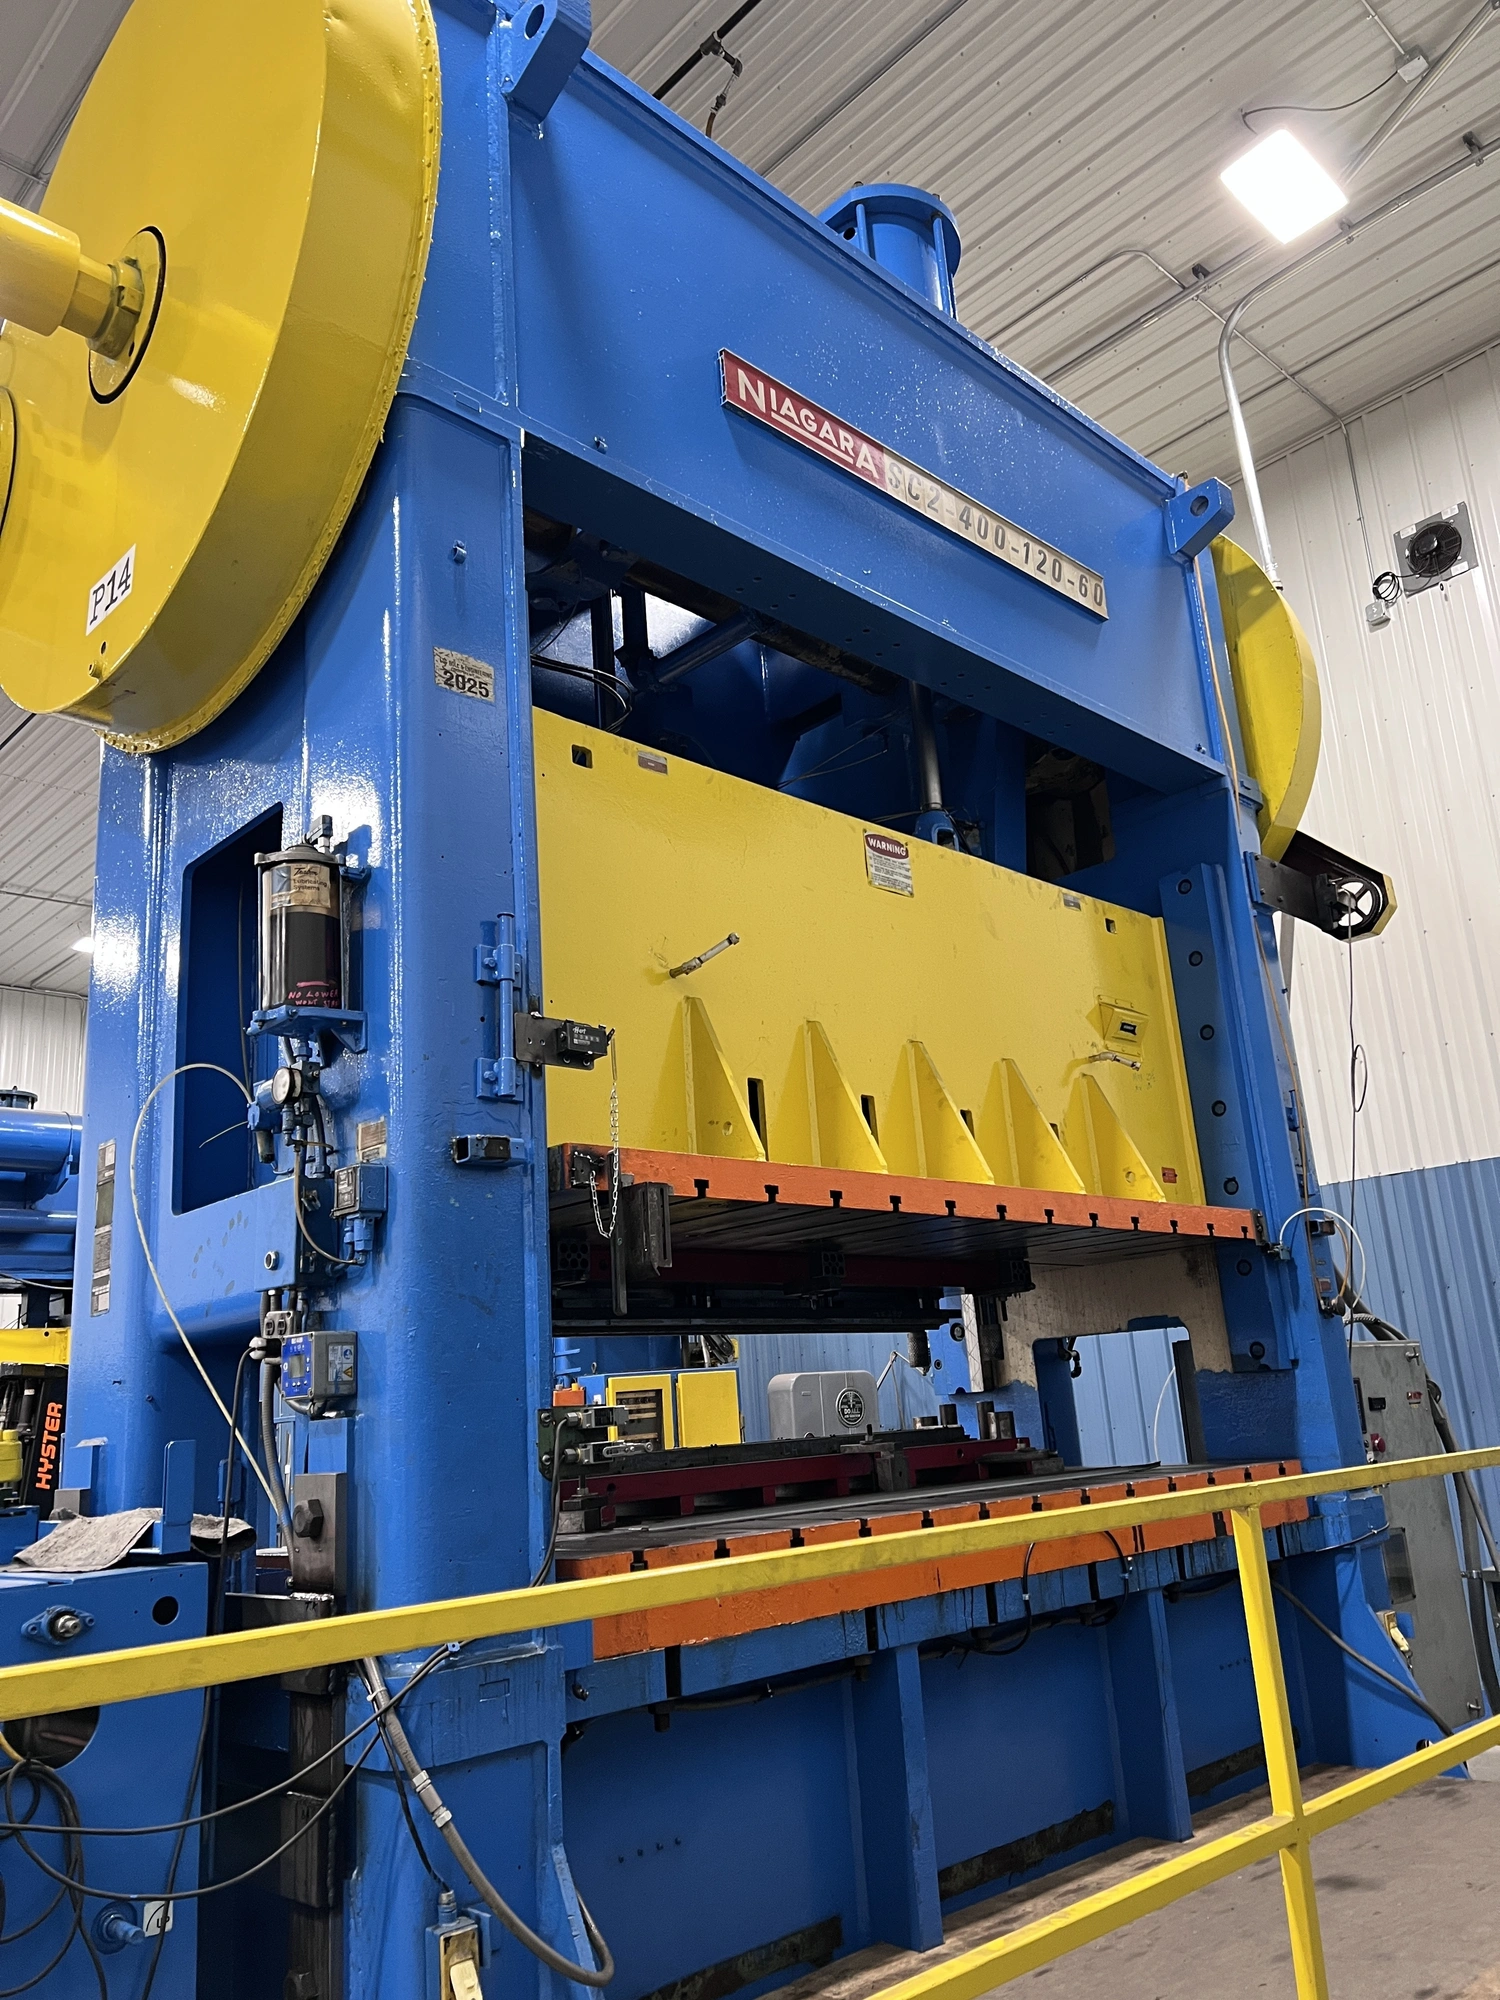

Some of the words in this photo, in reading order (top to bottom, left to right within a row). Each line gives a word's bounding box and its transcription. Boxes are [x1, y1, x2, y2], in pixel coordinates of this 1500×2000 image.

[737, 367, 880, 480] NIAGARA
[887, 461, 1104, 608] SC2-400-120-60
[89, 556, 132, 626] P14
[443, 669, 490, 698] 2025
[867, 837, 907, 856] WARNING
[293, 879, 328, 888] Lubricating
[288, 991, 302, 999] NO
[35, 1402, 63, 1490] HYSTER
